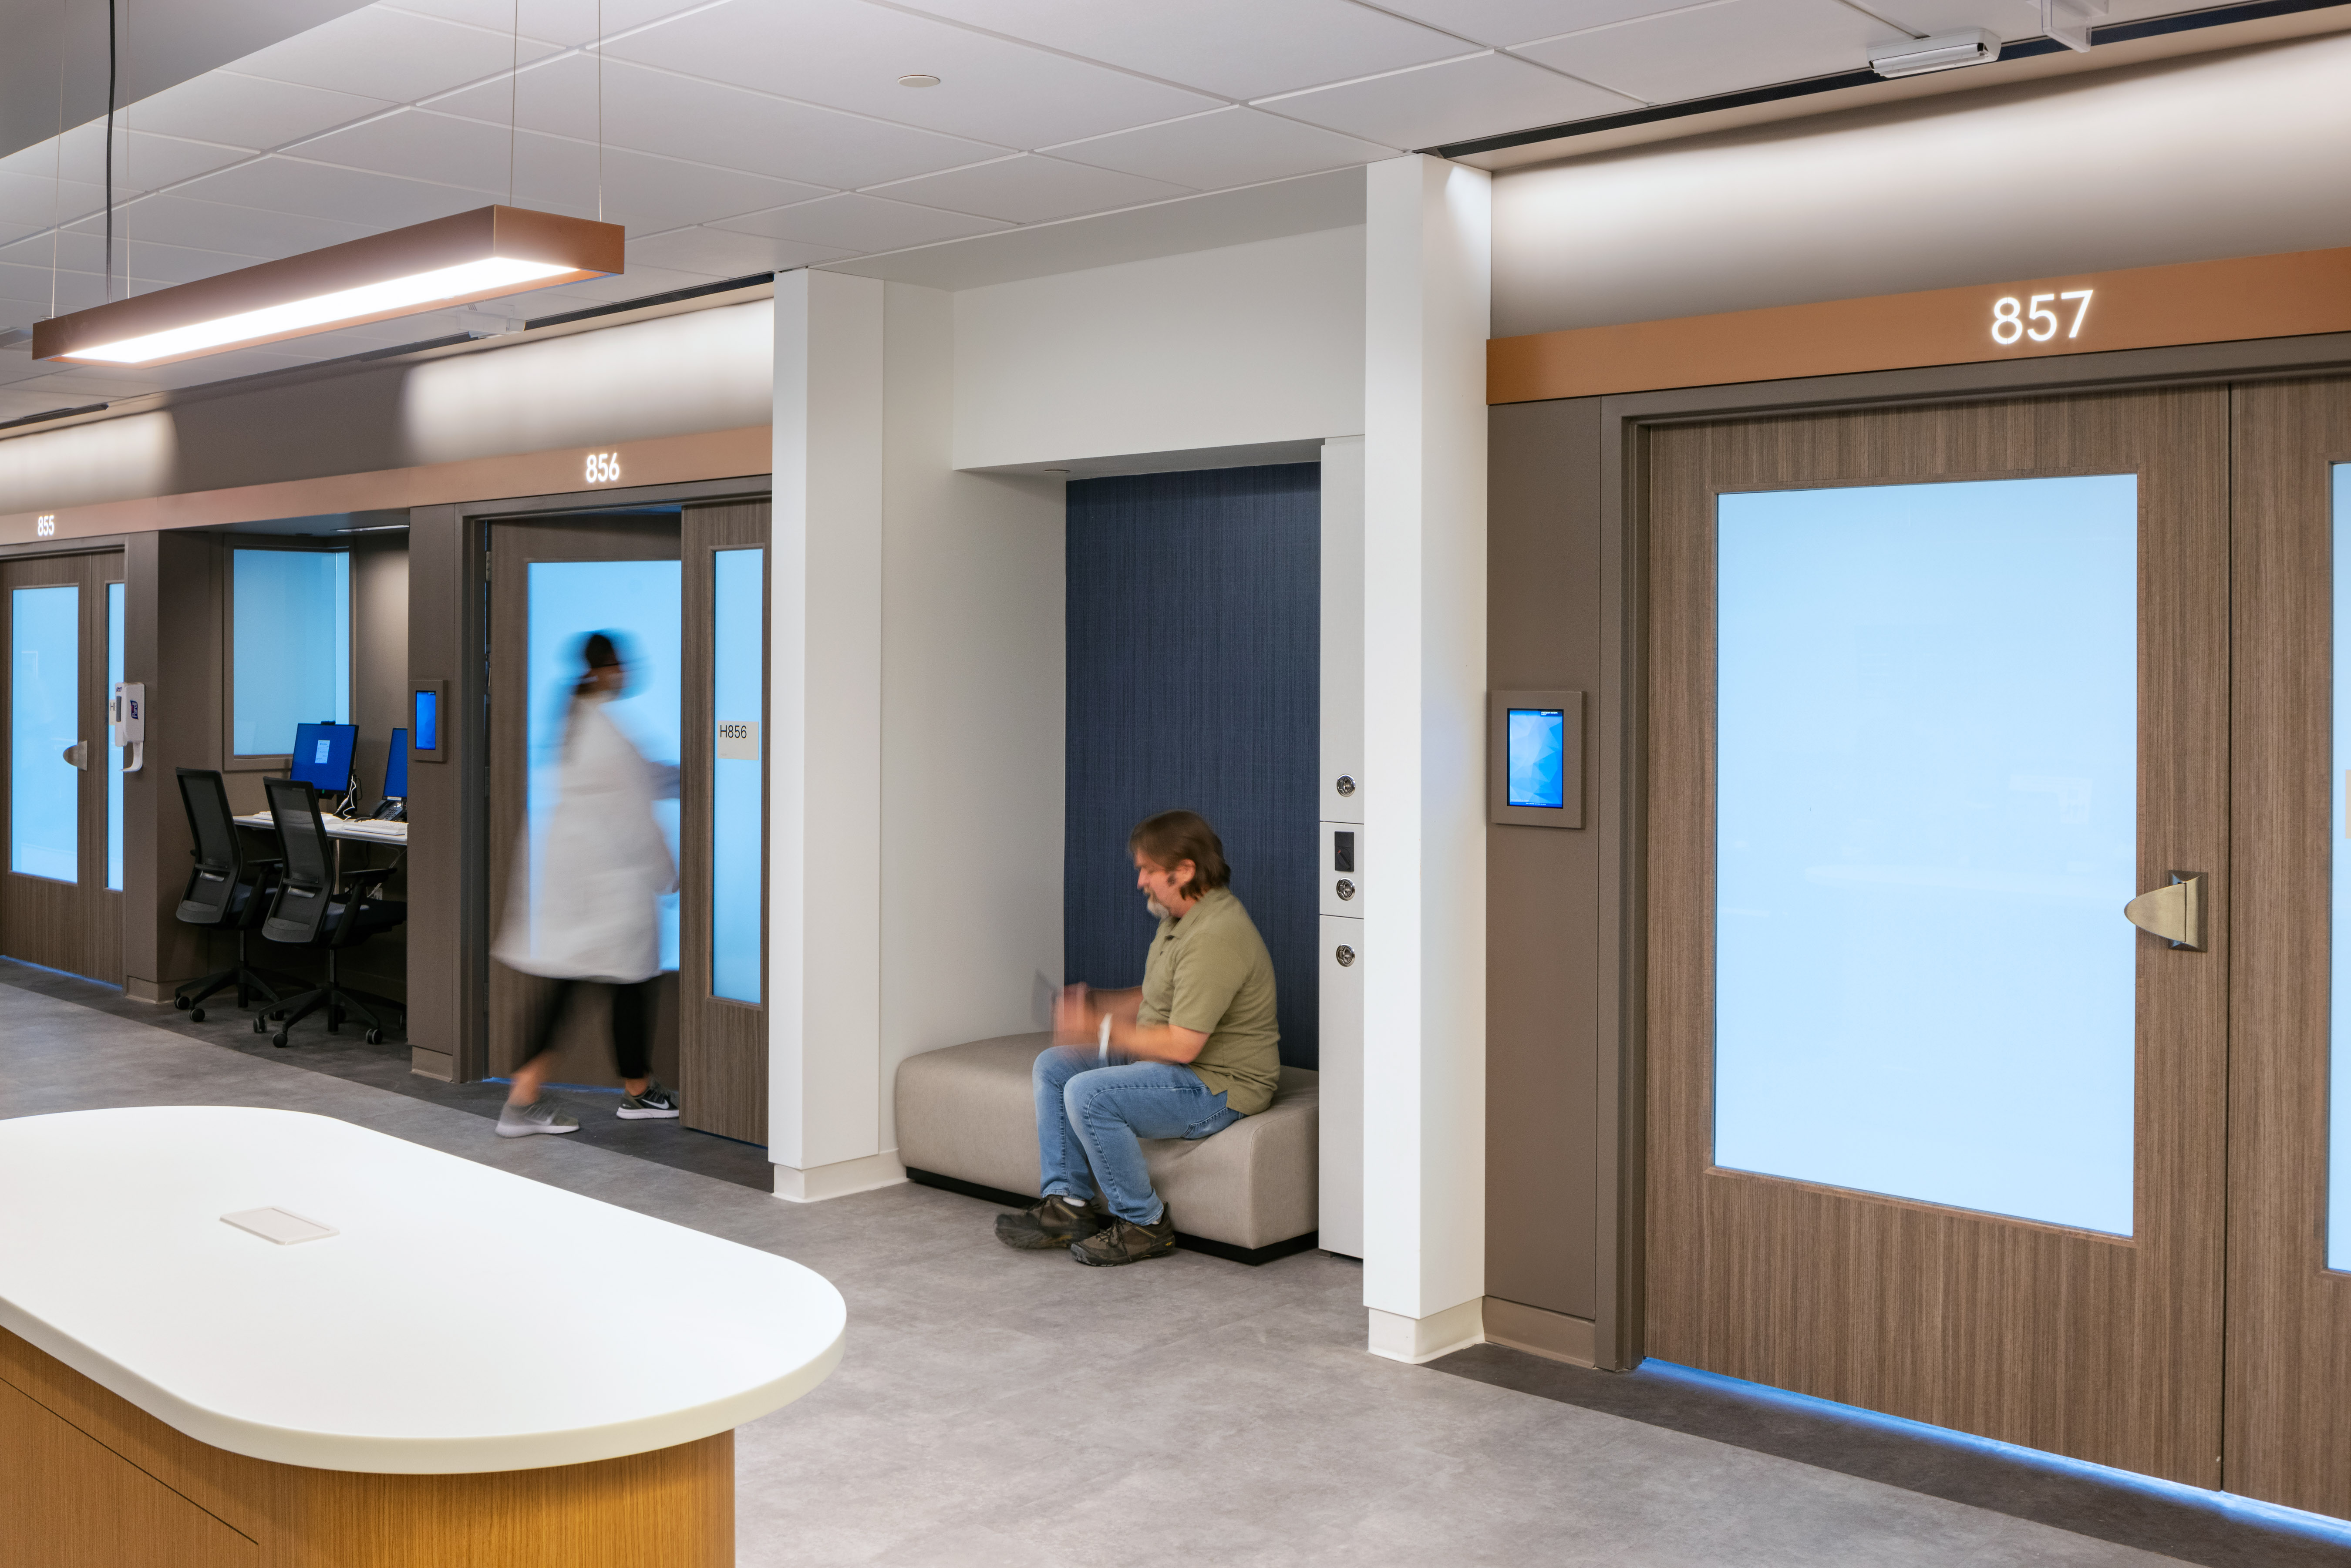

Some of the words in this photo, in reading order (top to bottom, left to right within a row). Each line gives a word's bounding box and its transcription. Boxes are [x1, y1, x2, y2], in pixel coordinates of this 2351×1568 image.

[1992, 289, 2093, 344] 857
[586, 452, 620, 483] 856
[37, 515, 54, 536] 855
[720, 724, 747, 739] H856
